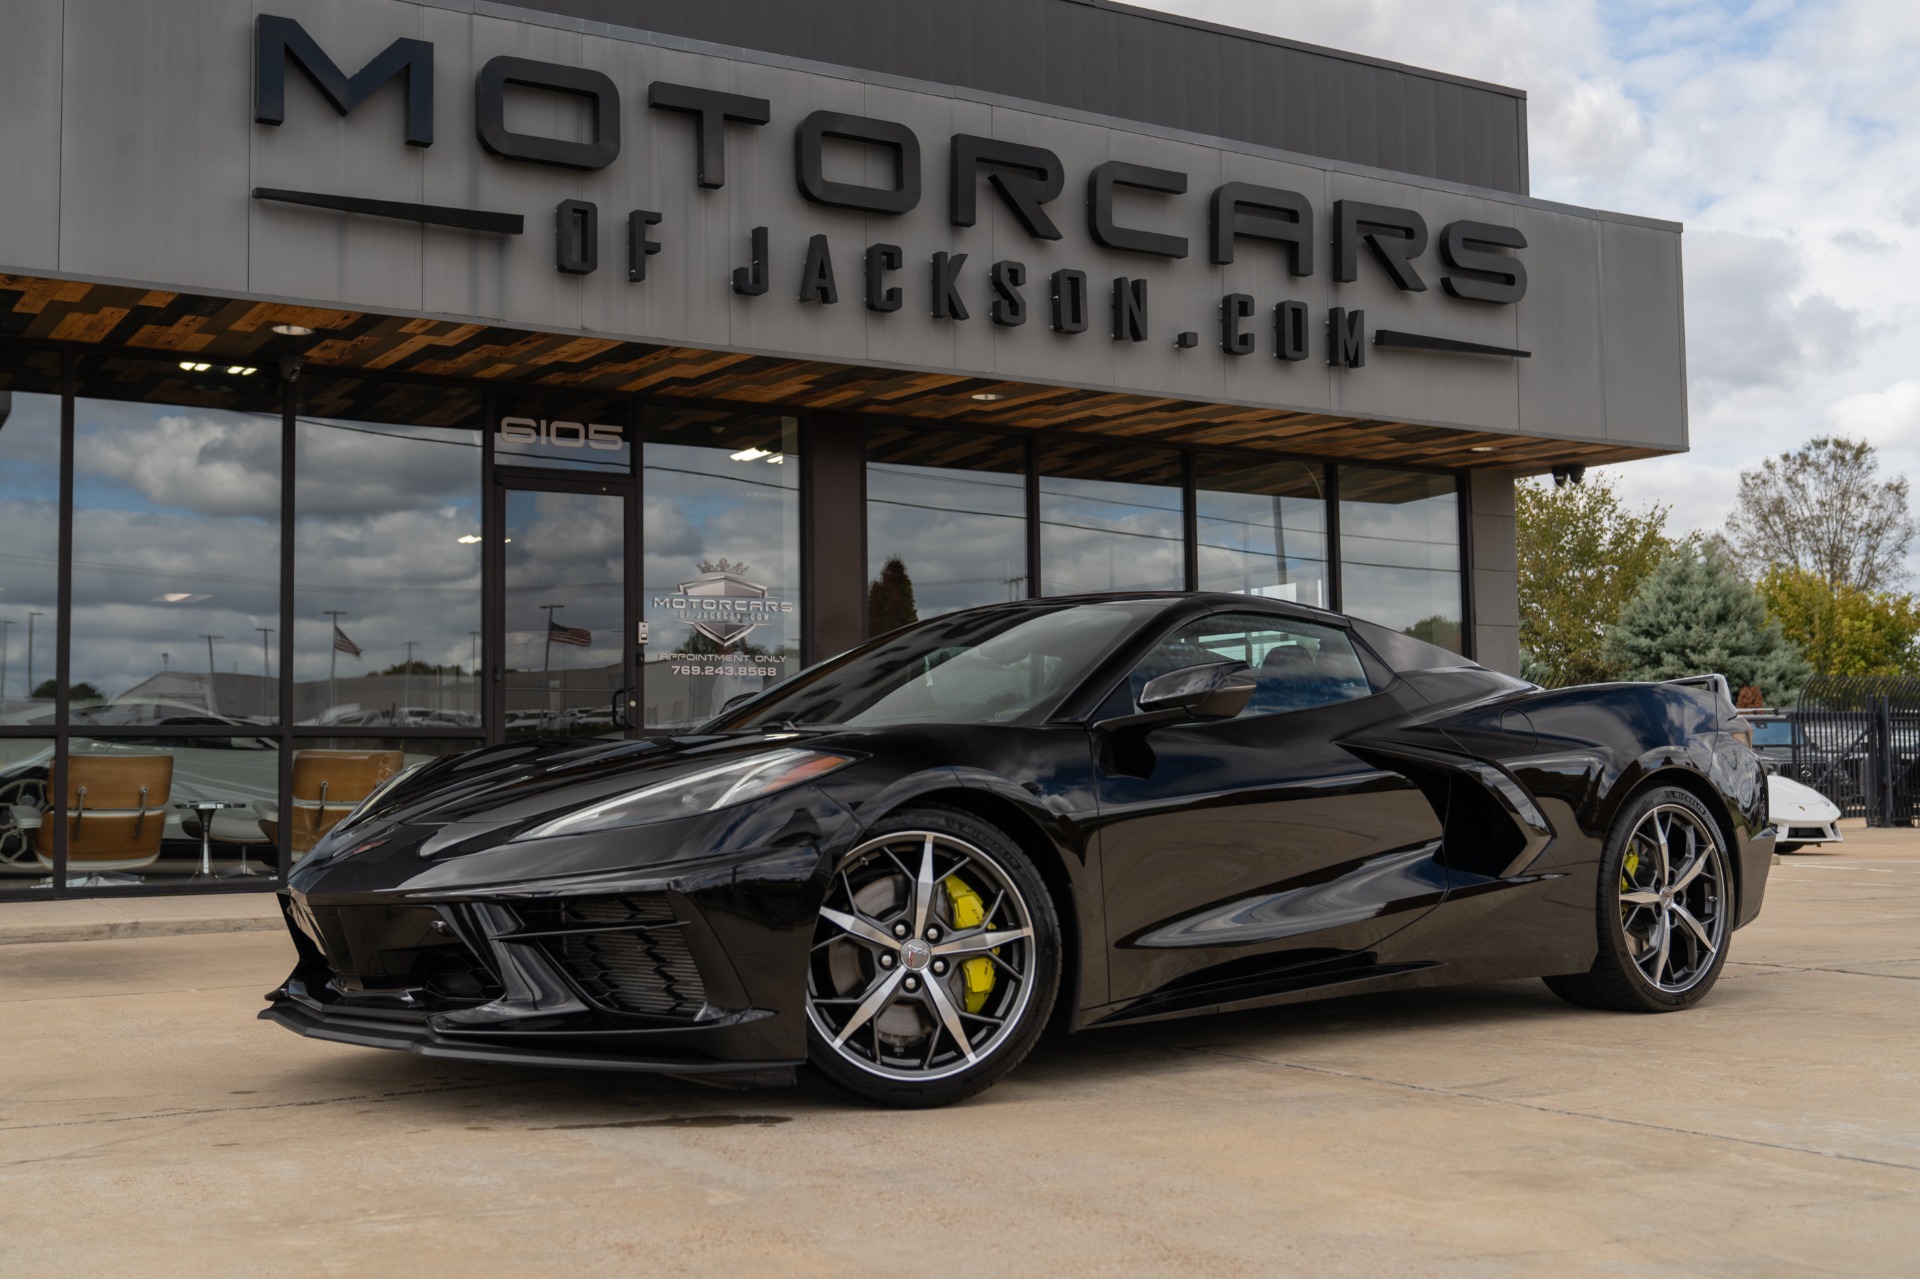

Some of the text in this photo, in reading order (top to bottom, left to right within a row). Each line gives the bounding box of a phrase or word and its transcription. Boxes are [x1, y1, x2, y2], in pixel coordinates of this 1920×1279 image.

[254, 13, 1528, 303] MOTORCARS
[555, 198, 662, 283] OF
[501, 416, 623, 451] 6105
[652, 597, 793, 612] MOTORCARS
[679, 611, 691, 619] OF
[658, 653, 787, 663] APPOINTMENT ONLY
[671, 665, 777, 677] 769.243.8568
[1674, 791, 1706, 814] MICHELIN
